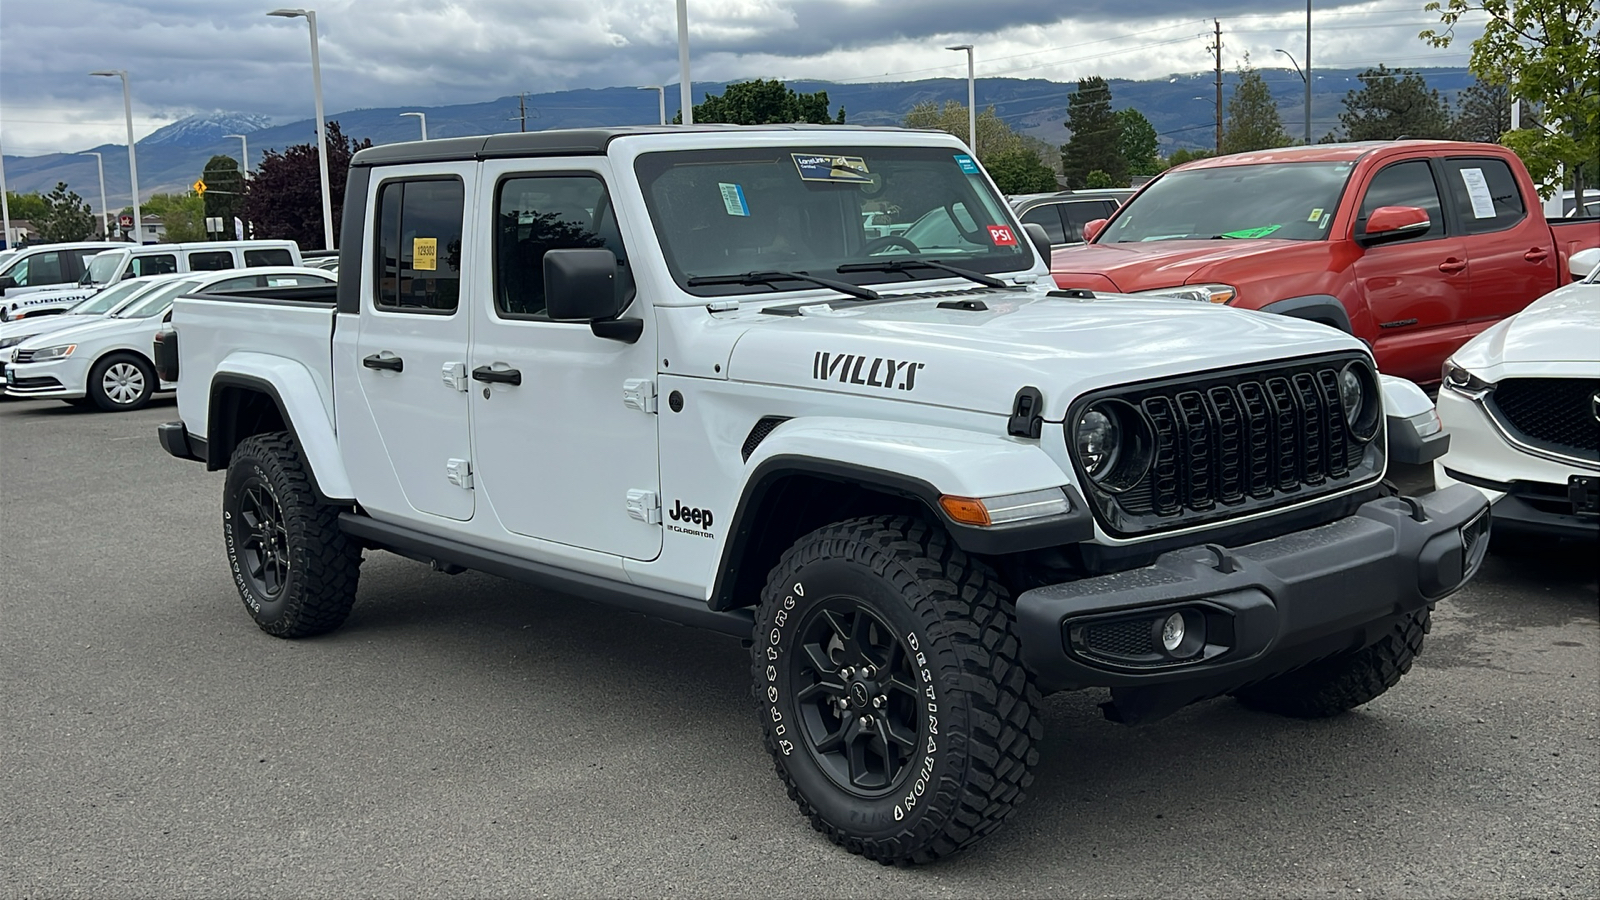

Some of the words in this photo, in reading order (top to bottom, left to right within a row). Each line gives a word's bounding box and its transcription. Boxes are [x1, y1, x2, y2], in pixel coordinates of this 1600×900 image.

[990, 229, 1012, 241] PSI
[24, 295, 86, 306] RUBICON
[813, 351, 925, 391] WILLYS
[669, 499, 713, 530] Jeep
[673, 525, 715, 539] GLADIATOR
[905, 632, 939, 811] DESTINATION
